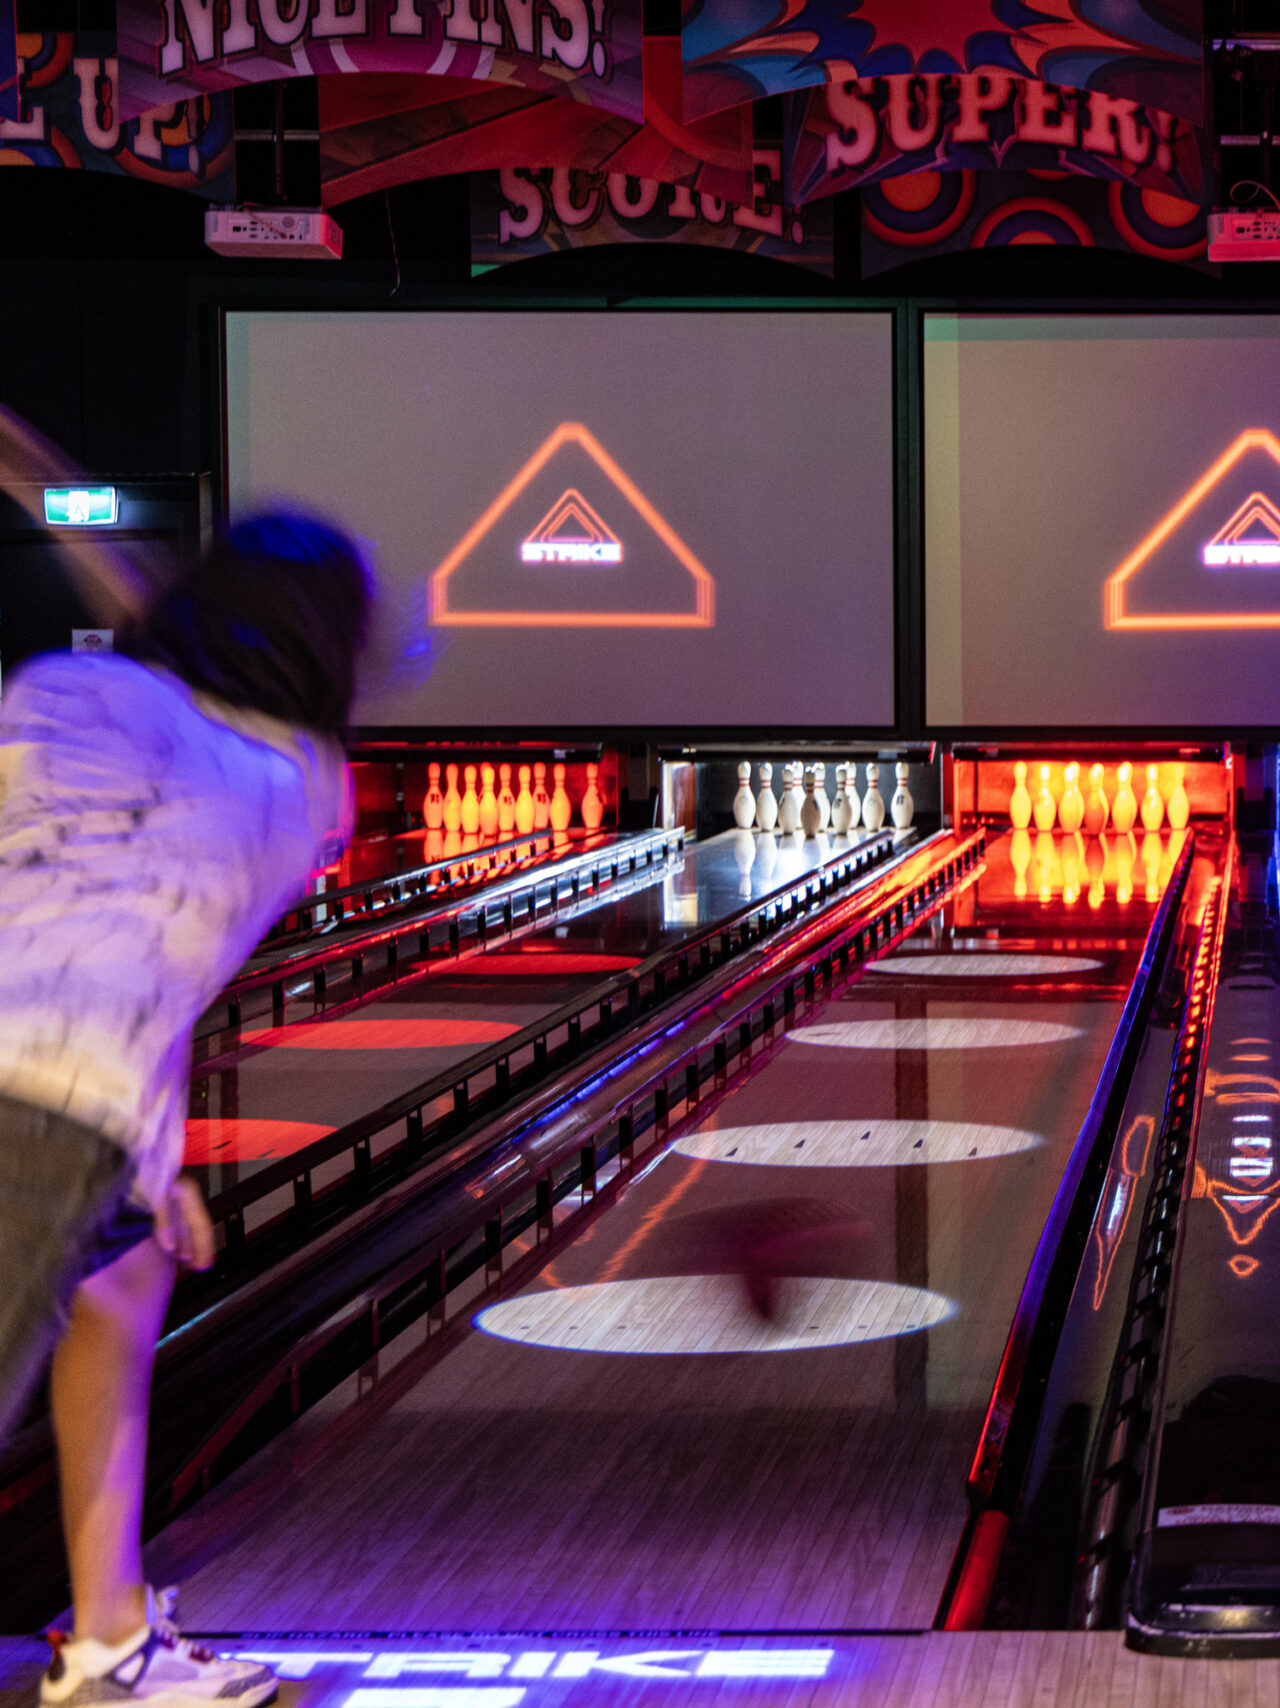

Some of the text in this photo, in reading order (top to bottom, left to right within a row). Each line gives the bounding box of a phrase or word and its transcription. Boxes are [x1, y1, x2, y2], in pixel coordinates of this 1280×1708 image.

[825, 74, 1177, 173] SUPER!
[521, 543, 622, 562] STRIKE
[219, 1650, 835, 1678] TRIKE
